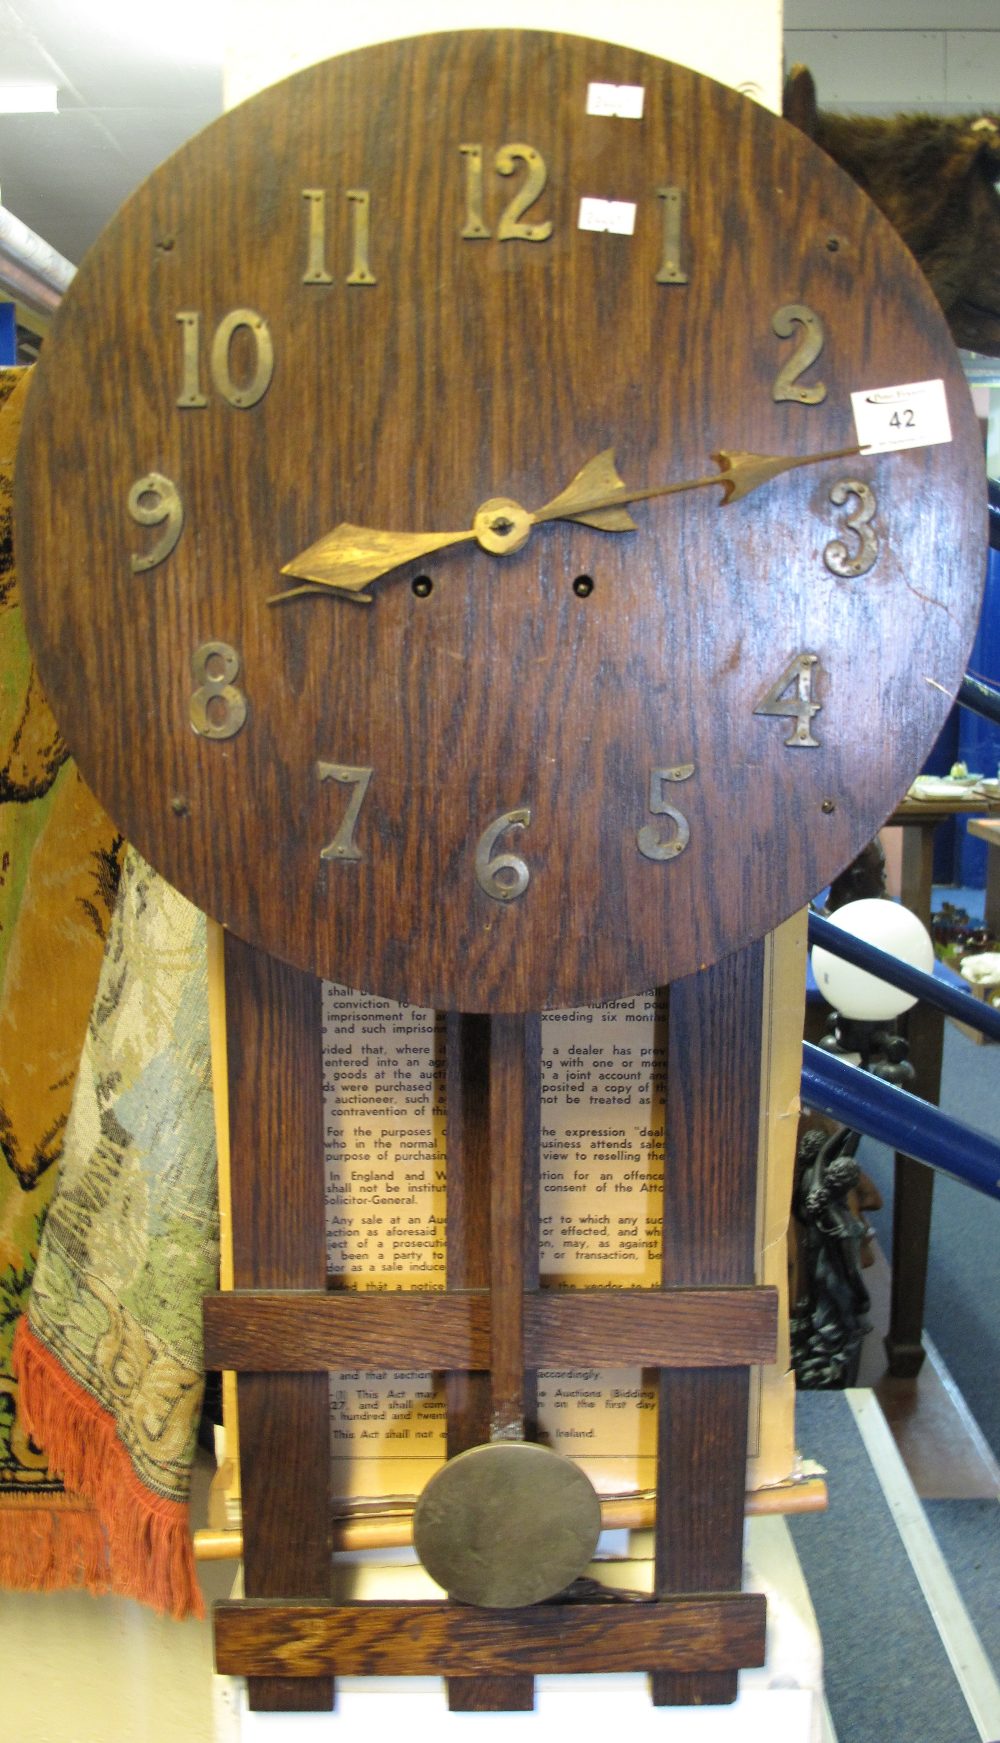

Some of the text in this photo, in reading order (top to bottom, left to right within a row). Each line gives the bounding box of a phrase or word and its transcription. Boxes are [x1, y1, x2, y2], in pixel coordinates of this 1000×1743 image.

[459, 143, 552, 242] 12
[302, 189, 376, 285] 11
[656, 187, 689, 284] 1
[175, 308, 274, 408] 10
[772, 304, 827, 405] 2
[889, 409, 916, 429] 42
[128, 472, 183, 573] 9
[824, 479, 879, 578] 3
[190, 641, 247, 740] 8
[753, 653, 822, 748] 4
[316, 760, 373, 860] 7
[636, 763, 695, 861] 5
[475, 807, 531, 900] 6
[333, 999, 390, 1009] conviction
[327, 1012, 403, 1022] imprisonment
[412, 1011, 427, 1020] for
[542, 1011, 593, 1023] xceeding
[601, 1012, 617, 1021] six
[334, 1023, 355, 1034] and
[361, 1023, 386, 1034] such
[321, 1044, 352, 1055] vided
[396, 1044, 430, 1054] where
[568, 1044, 604, 1055] dealer
[613, 1045, 632, 1055] has
[325, 1056, 369, 1067] entered
[377, 1057, 399, 1067] into
[560, 1057, 584, 1067] with
[592, 1060, 614, 1068] one
[621, 1060, 633, 1068] or
[333, 1069, 367, 1081] goods
[375, 1070, 385, 1079] at
[394, 1069, 412, 1079] the
[566, 1070, 591, 1081] joint
[599, 1071, 642, 1080] account
[341, 1084, 369, 1092] were
[375, 1081, 432, 1093] purchased
[542, 1082, 585, 1093] posited
[605, 1085, 632, 1094] copy
[638, 1083, 649, 1092] of
[405, 1094, 429, 1104] such
[566, 1094, 580, 1104] be
[590, 1095, 631, 1104] treated
[331, 1106, 425, 1116] contravention of
[327, 1127, 344, 1137] For
[354, 1127, 372, 1136] the
[381, 1129, 431, 1138] purposes
[542, 1127, 556, 1136] he
[565, 1128, 625, 1139] expression
[356, 1140, 365, 1148] in
[374, 1139, 392, 1148] the
[400, 1139, 437, 1148] normal
[541, 1139, 581, 1148] usiness
[590, 1139, 632, 1148] attends
[326, 1153, 371, 1162] purpose
[377, 1151, 388, 1160] of
[395, 1152, 447, 1162] purchasin
[543, 1151, 568, 1160] view
[576, 1152, 587, 1160] to
[593, 1151, 641, 1162] reselling
[330, 1171, 340, 1181] In
[351, 1171, 394, 1182] England
[405, 1171, 425, 1181] and
[541, 1171, 564, 1180] tion
[574, 1170, 590, 1180] for
[327, 1183, 351, 1193] shall
[360, 1184, 378, 1193] not
[386, 1183, 400, 1193] be
[408, 1183, 447, 1193] institut
[544, 1184, 587, 1193] consent
[596, 1183, 607, 1193] of
[615, 1183, 633, 1193] the
[361, 1215, 383, 1224] sale
[561, 1216, 572, 1224] to
[579, 1215, 610, 1224] which
[618, 1217, 638, 1226] any
[386, 1227, 437, 1236] aforesaid
[618, 1227, 638, 1236] and
[357, 1239, 368, 1248] of
[619, 1239, 657, 1249] against
[341, 1250, 369, 1259] been
[394, 1251, 422, 1260] party
[382, 1263, 404, 1271] sale
[410, 1262, 445, 1271] induce
